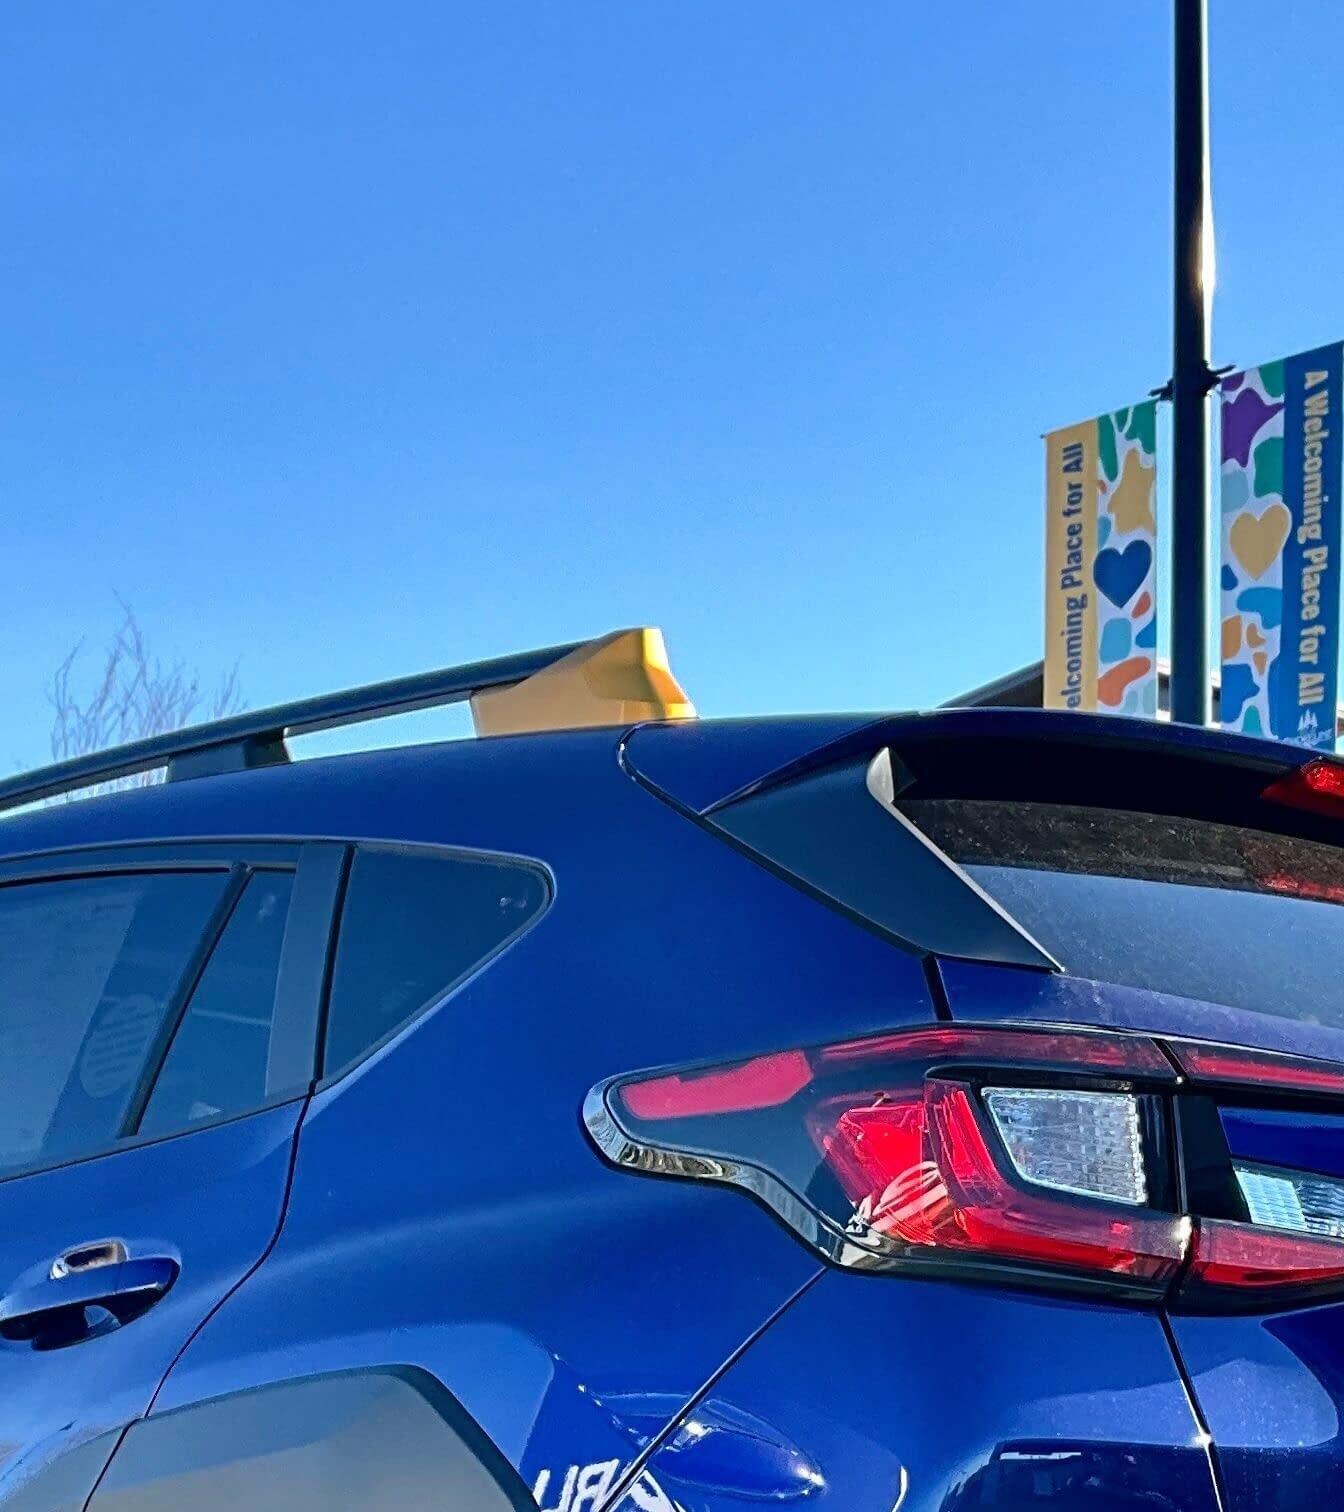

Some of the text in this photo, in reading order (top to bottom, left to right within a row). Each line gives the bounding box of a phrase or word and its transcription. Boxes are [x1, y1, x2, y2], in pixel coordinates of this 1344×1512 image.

[1304, 370, 1329, 390] A
[1297, 389, 1330, 544] Welcoming
[1060, 442, 1088, 709] elcoming Place for All
[1301, 545, 1329, 621] Place
[1299, 624, 1326, 665] for
[1298, 672, 1325, 706] All
